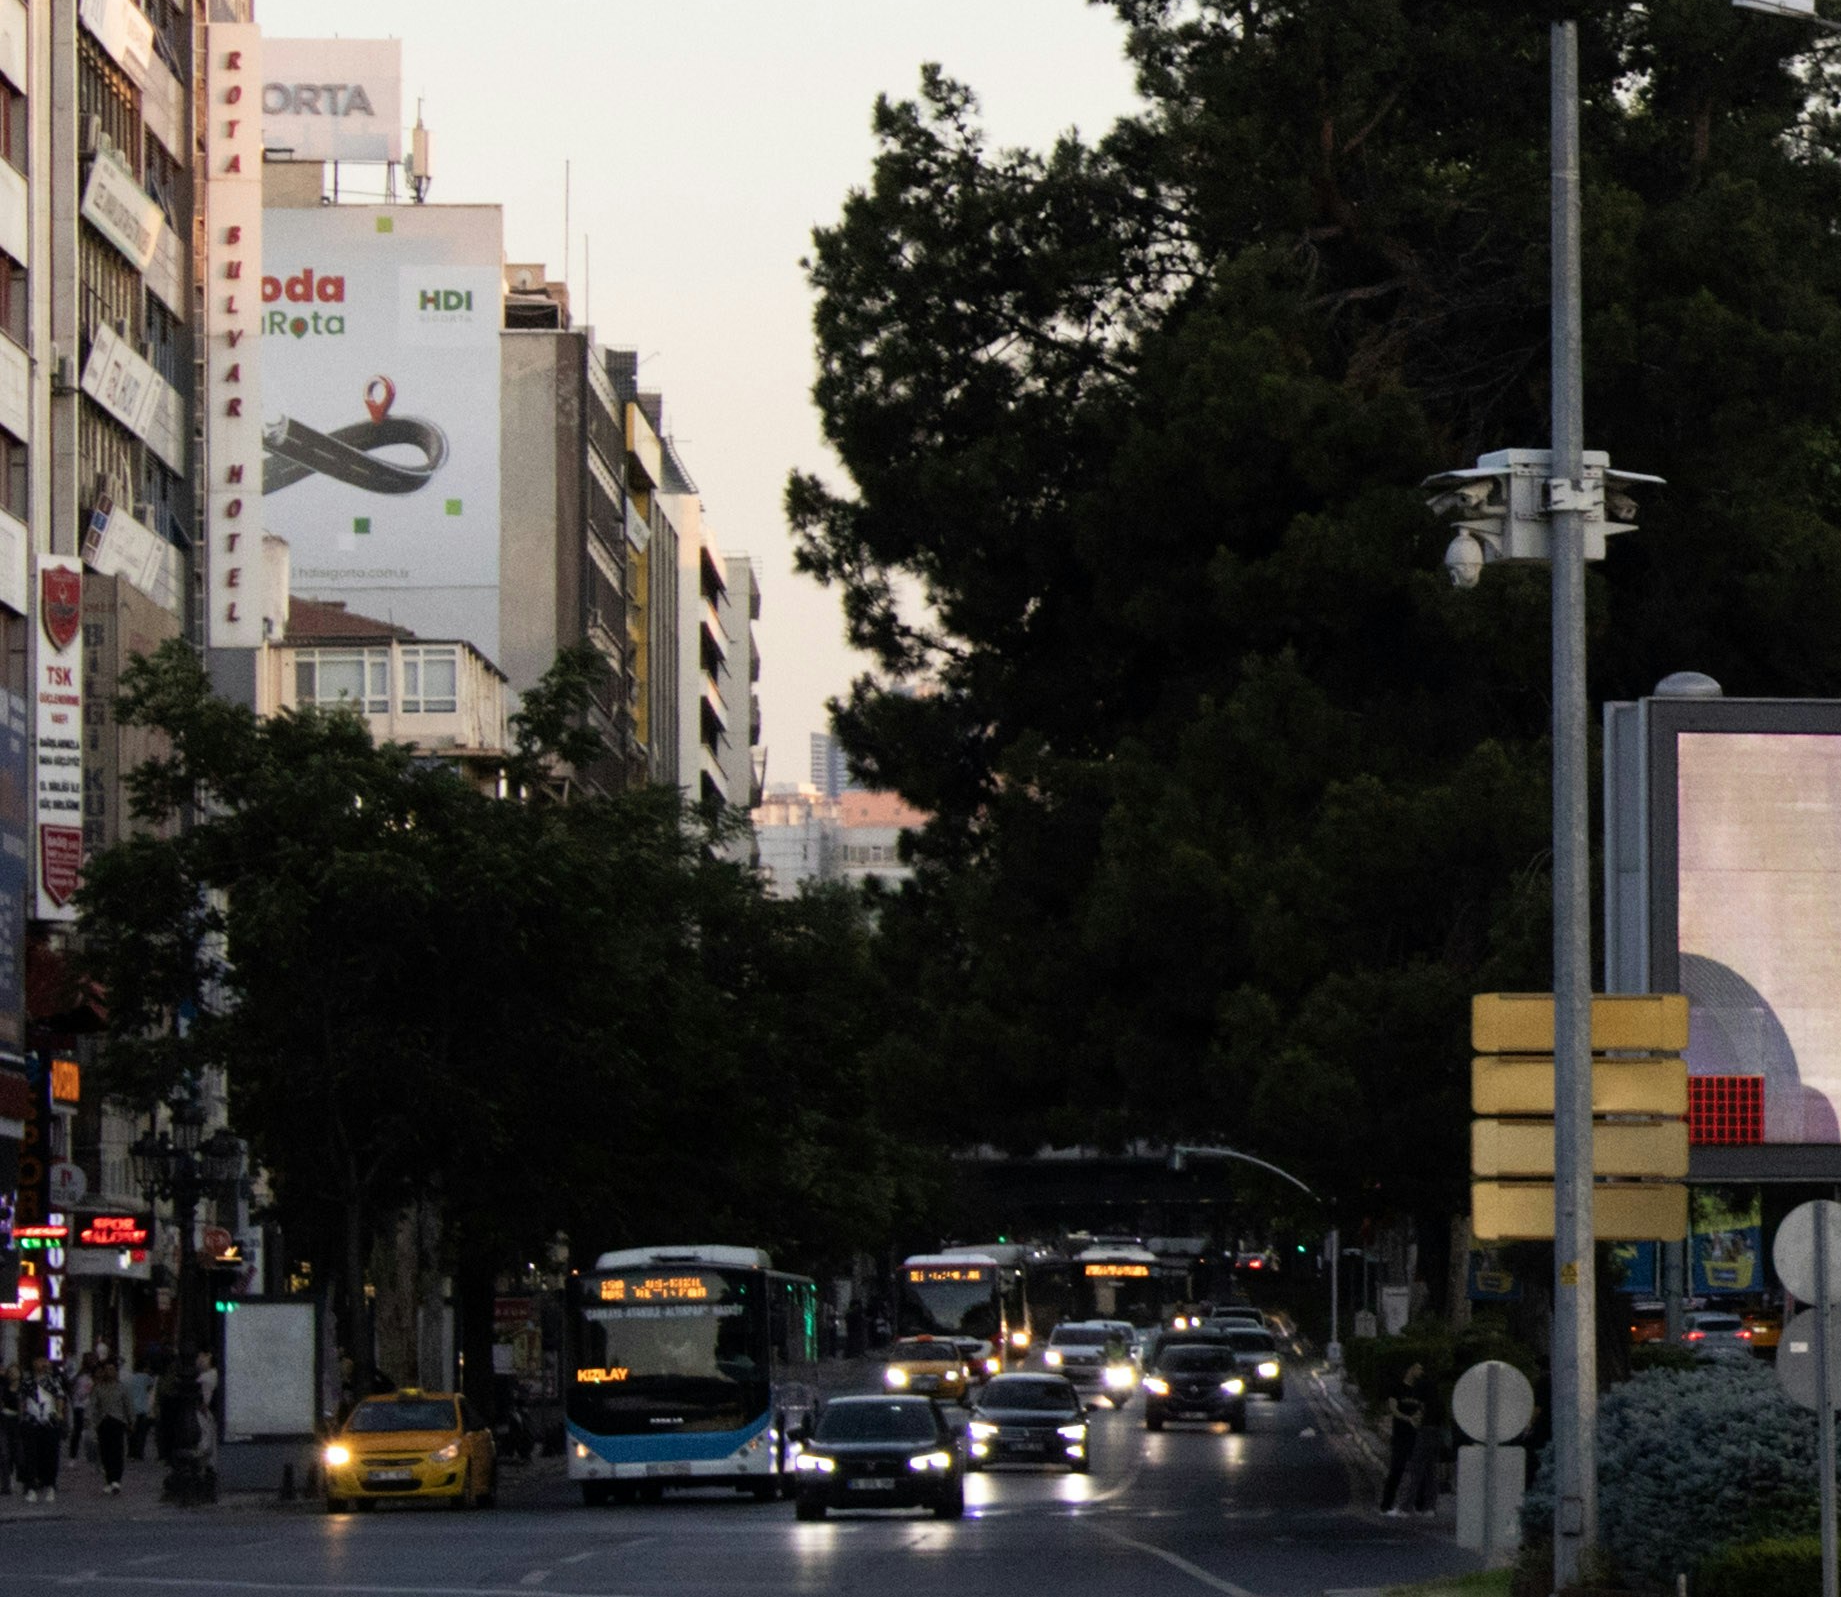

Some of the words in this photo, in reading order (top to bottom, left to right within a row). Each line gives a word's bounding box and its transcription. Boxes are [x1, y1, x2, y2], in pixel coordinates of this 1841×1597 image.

[225, 50, 243, 175] ROTA
[225, 224, 243, 419] BULVAR
[418, 289, 474, 312] HDI
[225, 464, 243, 624] HOTEL
[46, 666, 73, 687] TSK
